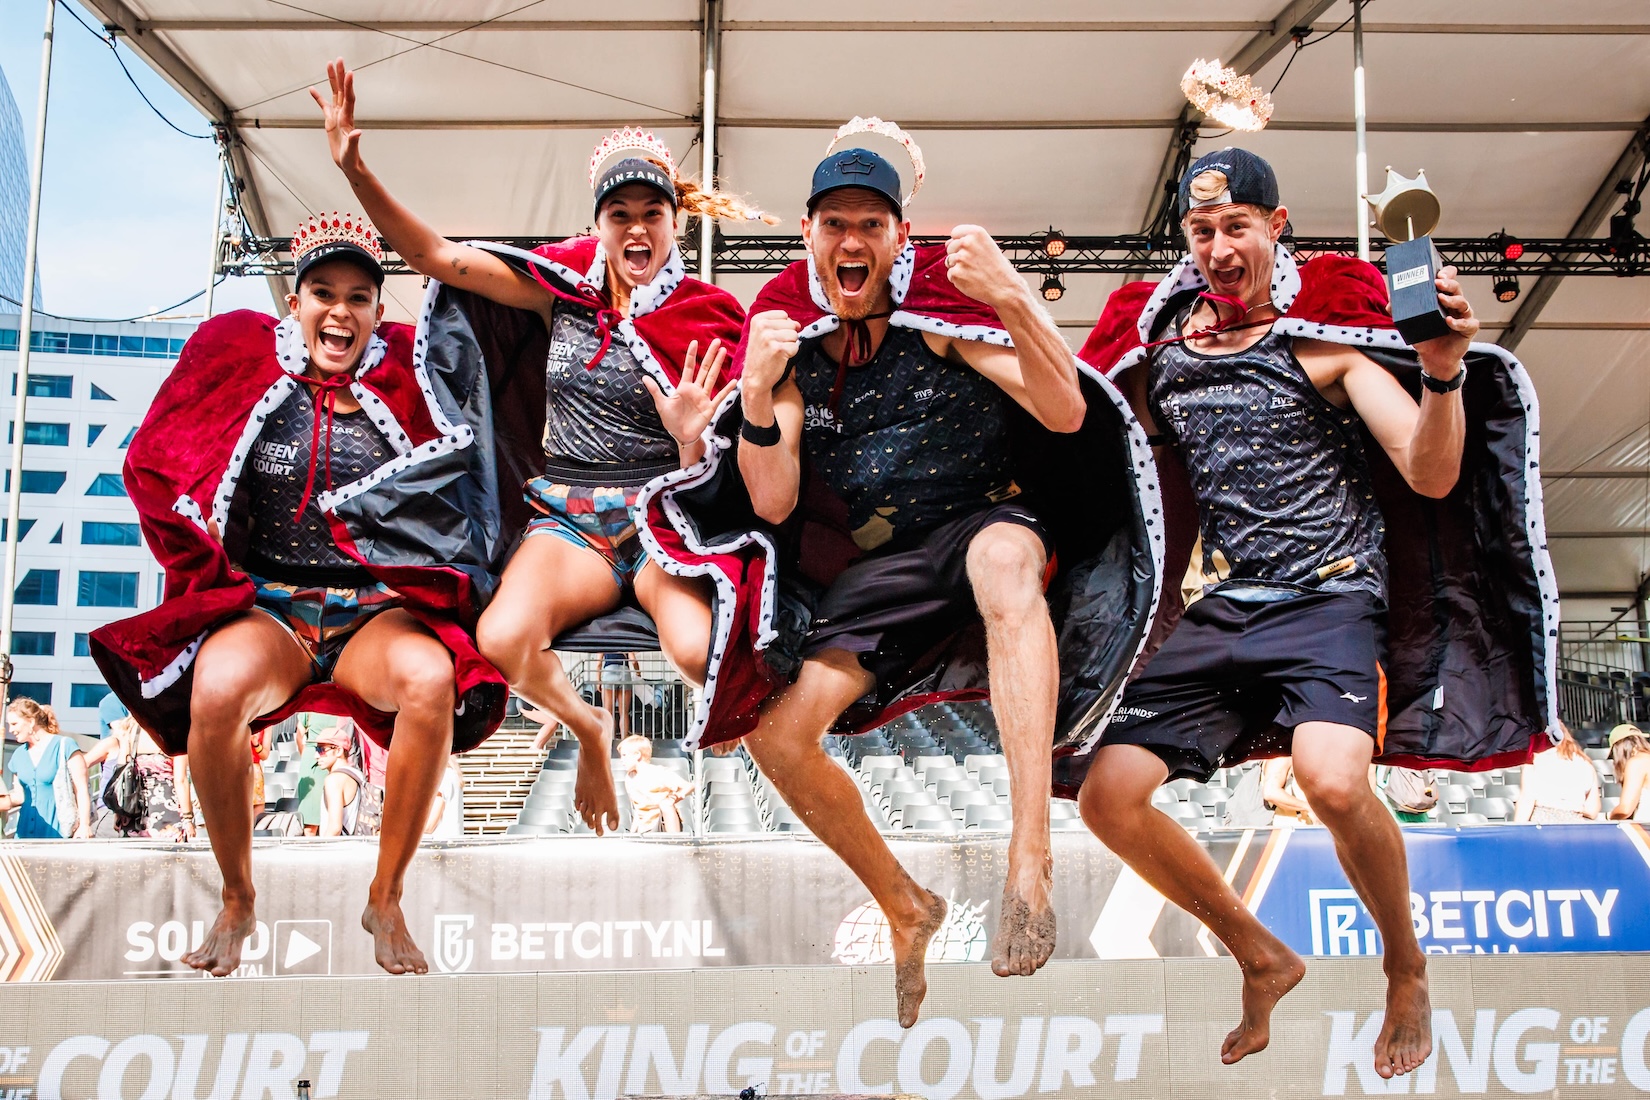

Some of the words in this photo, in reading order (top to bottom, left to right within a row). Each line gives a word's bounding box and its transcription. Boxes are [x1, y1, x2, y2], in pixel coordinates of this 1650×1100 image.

[602, 171, 664, 191] ZINZANE
[1397, 267, 1425, 282] WINNER
[254, 440, 298, 460] QUEEN
[253, 458, 294, 476] COURT
[490, 919, 726, 961] BETCITY.NL
[785, 1030, 827, 1058] OF
[1569, 1016, 1609, 1044] OF
[527, 1021, 777, 1100] KING
[836, 1014, 1164, 1100] COURT
[1321, 1007, 1562, 1095] KNG
[37, 1031, 370, 1100] COURT
[1563, 1057, 1618, 1085] THE
[775, 1072, 832, 1095] THE
